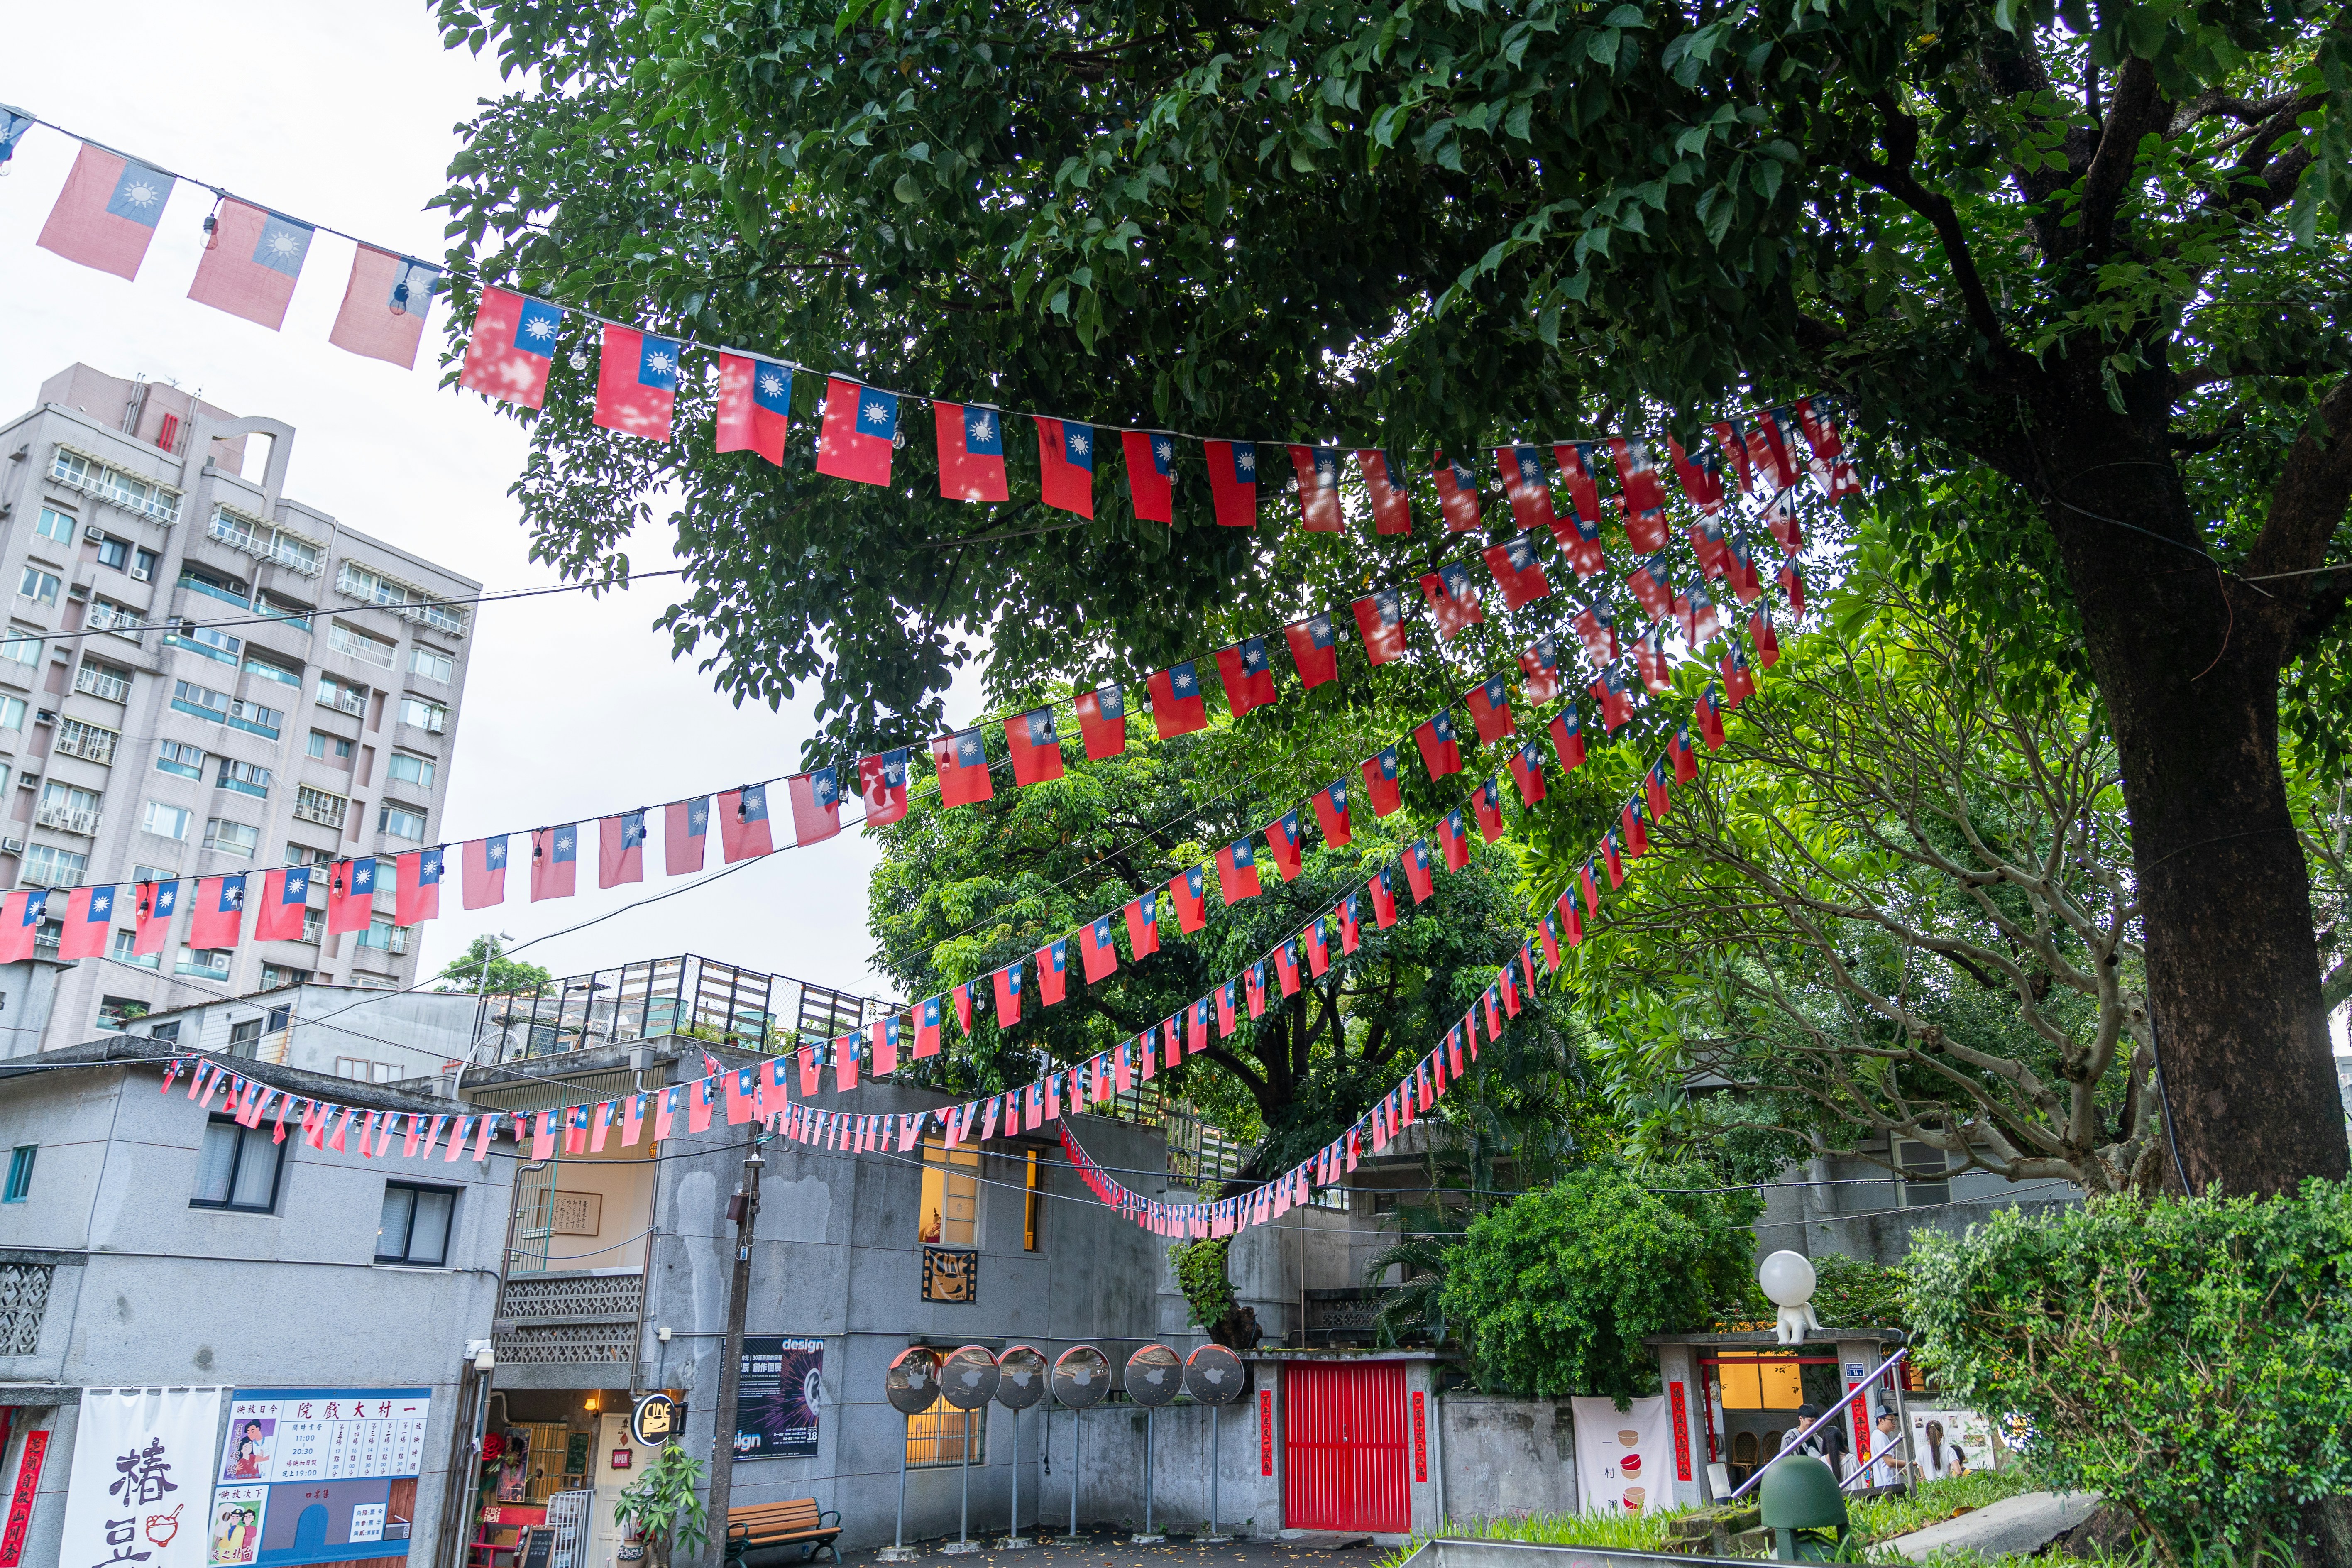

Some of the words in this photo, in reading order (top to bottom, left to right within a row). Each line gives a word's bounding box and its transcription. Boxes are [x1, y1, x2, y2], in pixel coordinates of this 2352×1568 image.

[933, 1253, 968, 1277] CINE
[782, 1338, 824, 1354] design
[753, 1362, 782, 1372] 創作個展
[297, 1401, 416, 1419] 一村大戲院
[645, 1403, 670, 1419] CINE
[614, 1454, 627, 1464] OPEN
[306, 1489, 329, 1499] 售票口
